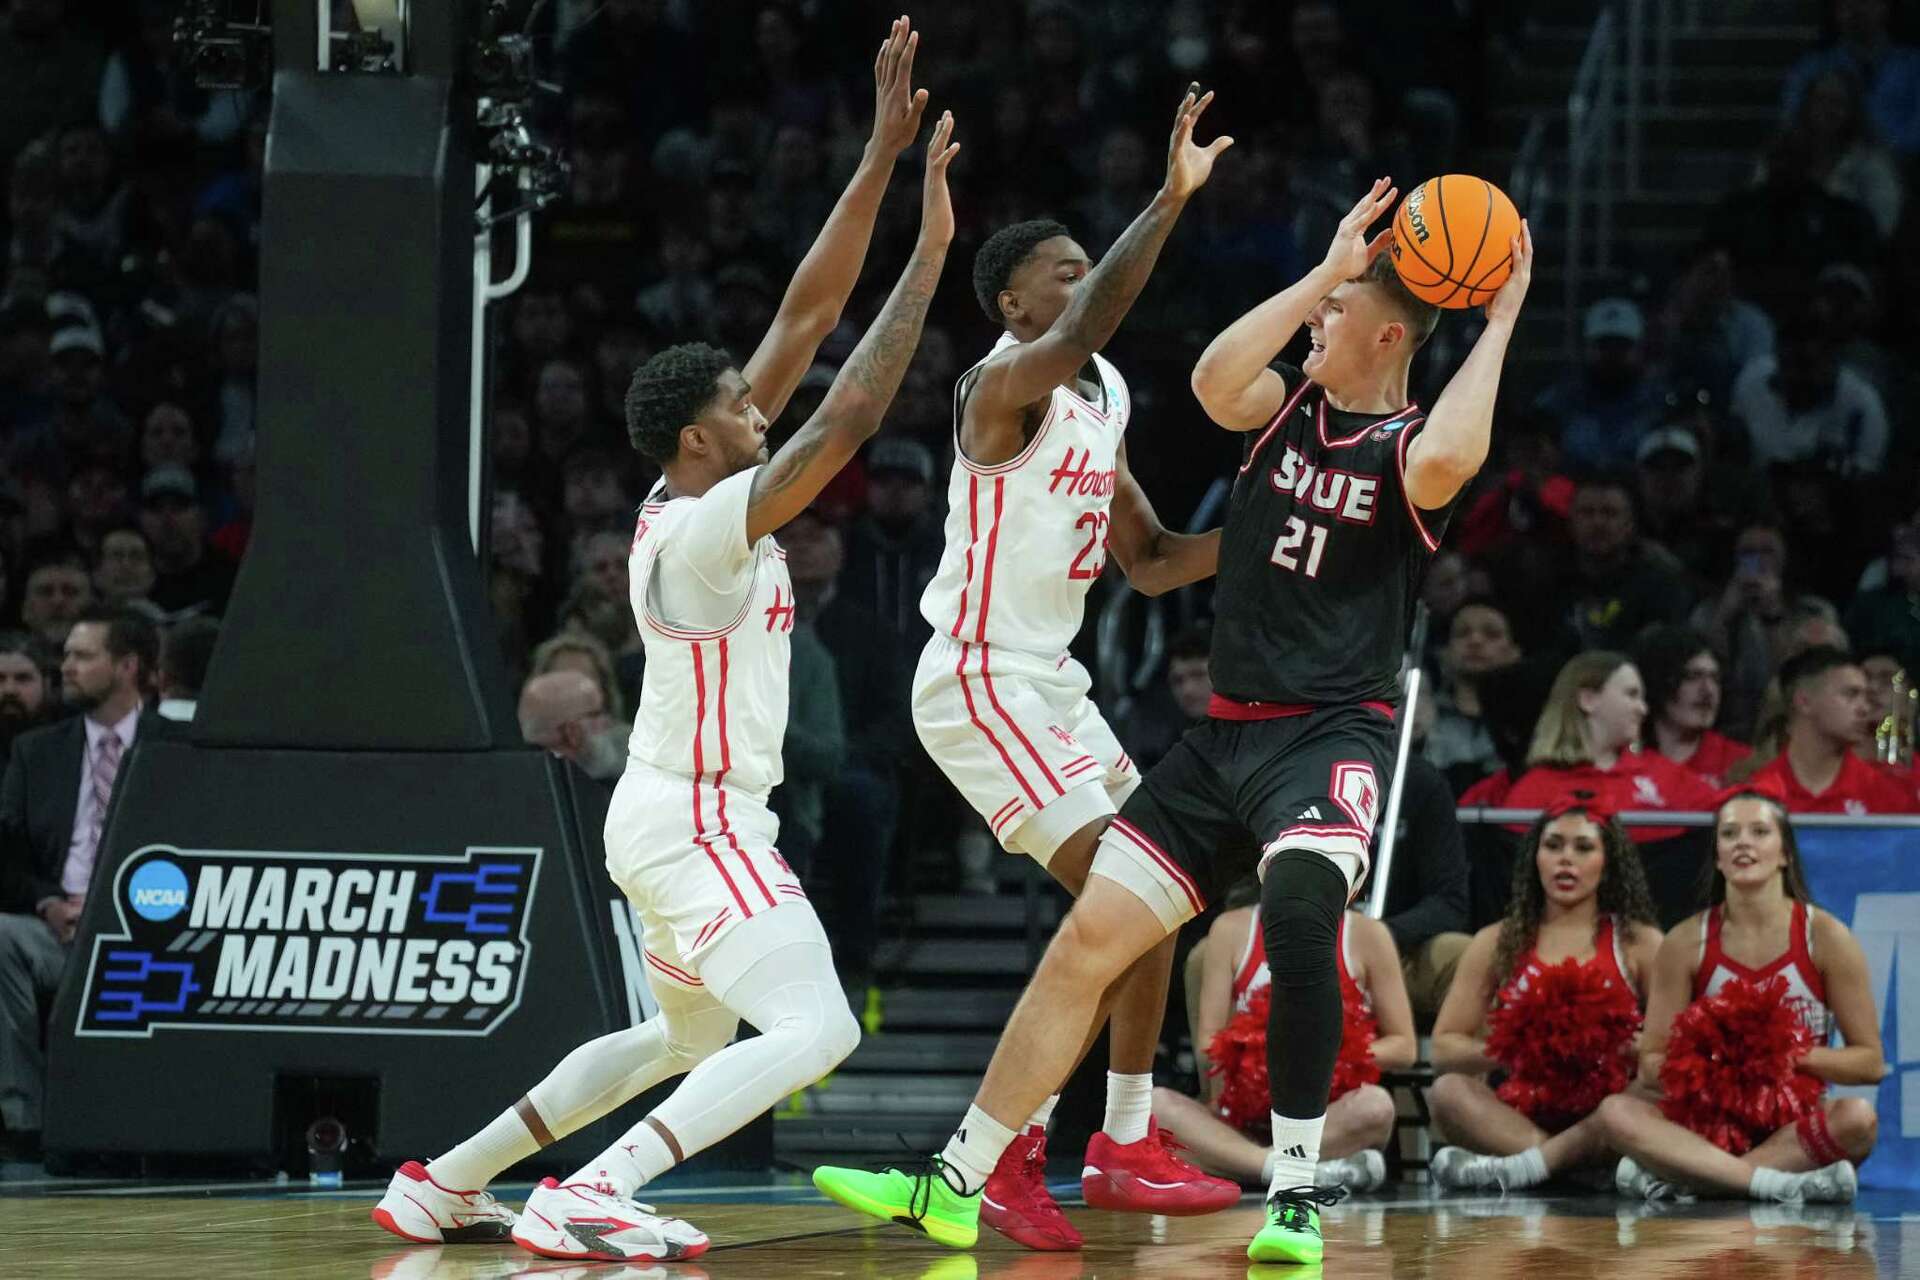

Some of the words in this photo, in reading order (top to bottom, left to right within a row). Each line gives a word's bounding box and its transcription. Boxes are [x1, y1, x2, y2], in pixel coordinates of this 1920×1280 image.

[1272, 446, 1378, 522] SIUE
[1271, 514, 1329, 578] 21
[135, 888, 186, 906] NCAA
[188, 864, 416, 933] MARCH
[212, 934, 517, 1003] MADNESS
